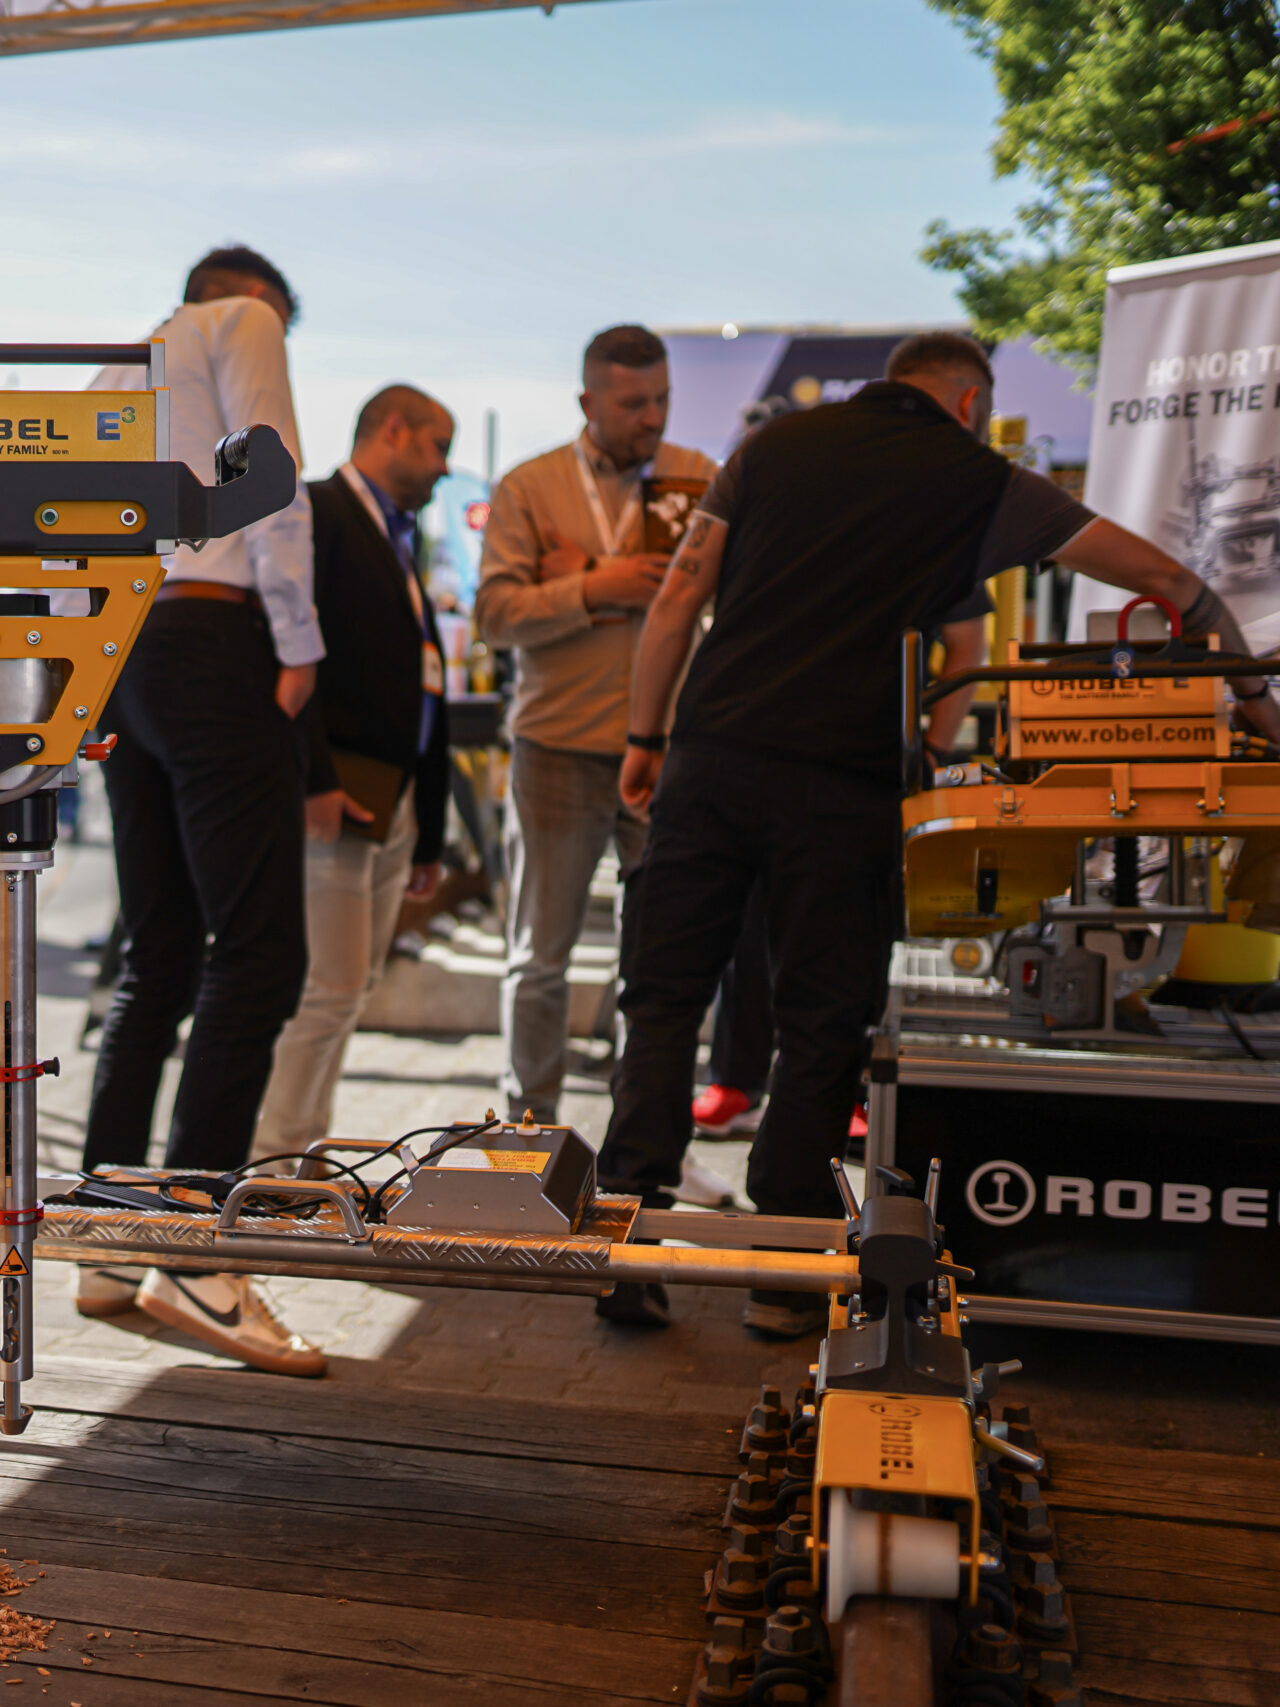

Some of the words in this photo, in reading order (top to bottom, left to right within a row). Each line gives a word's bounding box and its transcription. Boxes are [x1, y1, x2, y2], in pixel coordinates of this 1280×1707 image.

[1147, 348, 1250, 386] HONOR
[1109, 391, 1200, 426] FORGE
[1210, 383, 1265, 415] THE
[7, 444, 48, 455] FAMILY
[1021, 723, 1215, 744] www.robel.com
[1045, 1175, 1280, 1227] ROBE
[880, 1418, 914, 1480] ROBEL
